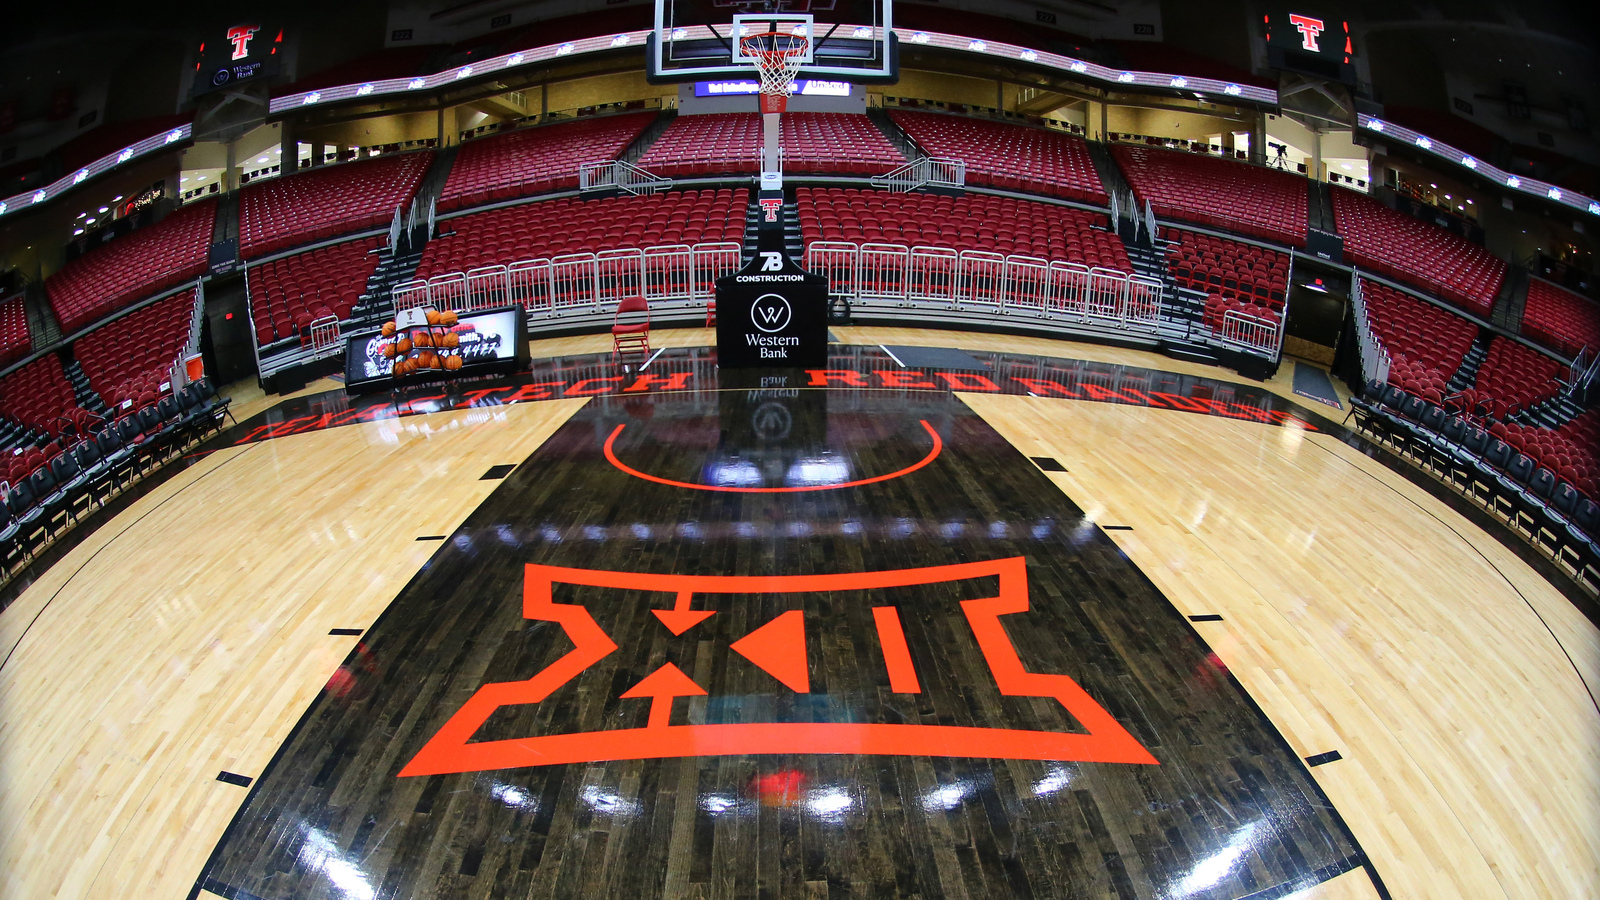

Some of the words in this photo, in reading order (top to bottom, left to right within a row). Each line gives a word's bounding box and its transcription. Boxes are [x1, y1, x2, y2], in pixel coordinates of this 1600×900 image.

[668, 30, 687, 40] ABF
[792, 27, 808, 36] AB
[852, 29, 873, 39] ABF
[610, 36, 630, 47] ABF
[910, 34, 930, 44] ABF
[555, 44, 575, 56] ABF
[968, 42, 987, 52] ABF
[506, 54, 524, 67] ABF
[1020, 51, 1038, 62] ABF
[456, 67, 473, 79] ABF
[1070, 62, 1087, 73] ABF
[1118, 74, 1135, 83] ABF
[1170, 79, 1187, 88] ABF
[356, 85, 374, 96] ABF
[407, 80, 425, 90] ABF
[1224, 86, 1242, 96] ABF
[302, 94, 321, 105] ABF
[1367, 120, 1384, 133] ABF
[165, 130, 183, 144] ABF
[1416, 137, 1432, 150] ABF
[117, 149, 134, 163] ABF
[73, 169, 90, 185] ABF
[736, 274, 804, 283] CONSTRUCTION
[745, 334, 799, 346] Western
[760, 347, 788, 359] Bank
[234, 394, 448, 444] TEXAS
[454, 372, 694, 407] TECH
[804, 369, 1001, 391] RED
[1010, 377, 1319, 431] RAIDERS
